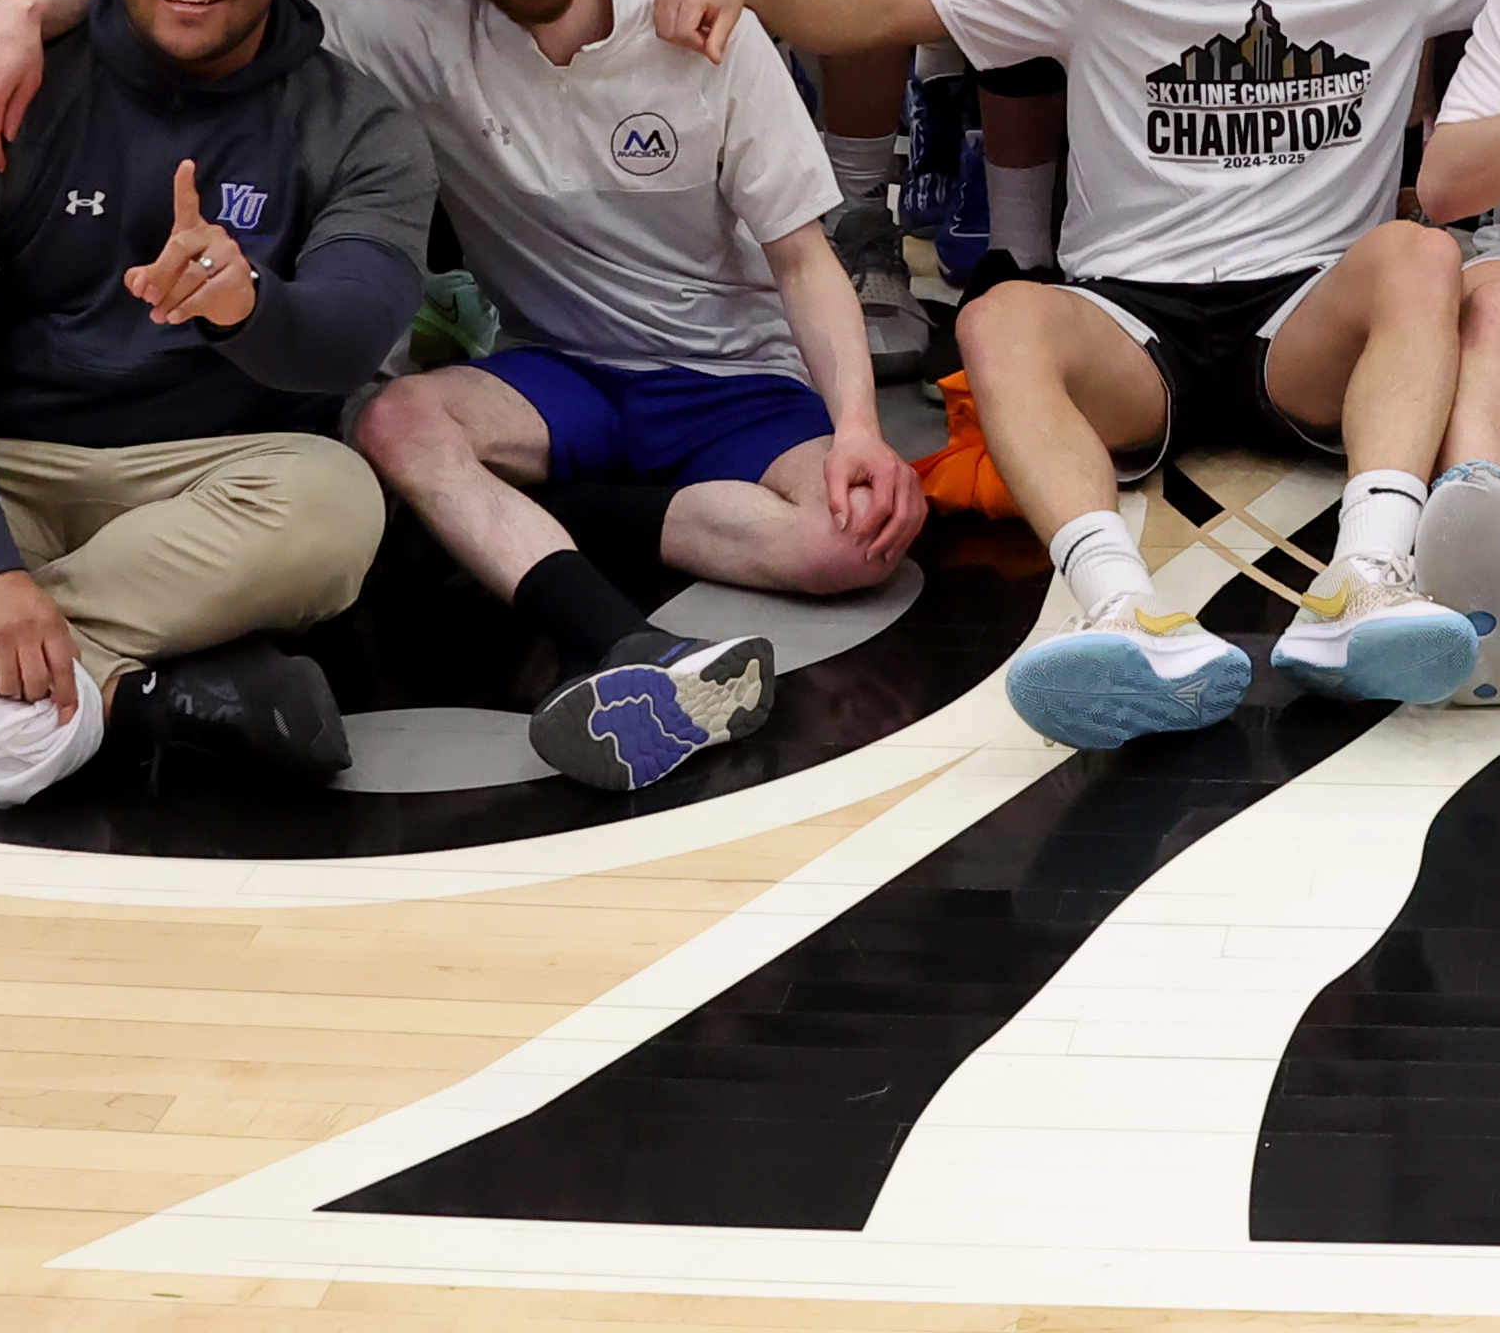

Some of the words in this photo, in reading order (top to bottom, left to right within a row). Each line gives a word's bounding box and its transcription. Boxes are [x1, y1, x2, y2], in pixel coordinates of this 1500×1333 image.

[1146, 81, 1238, 106] SKYLINE
[1240, 68, 1373, 106] CONFERENCE
[1146, 97, 1363, 157] CHAMPIONS
[1223, 153, 1306, 170] 2024-2025
[217, 182, 269, 229] YU
